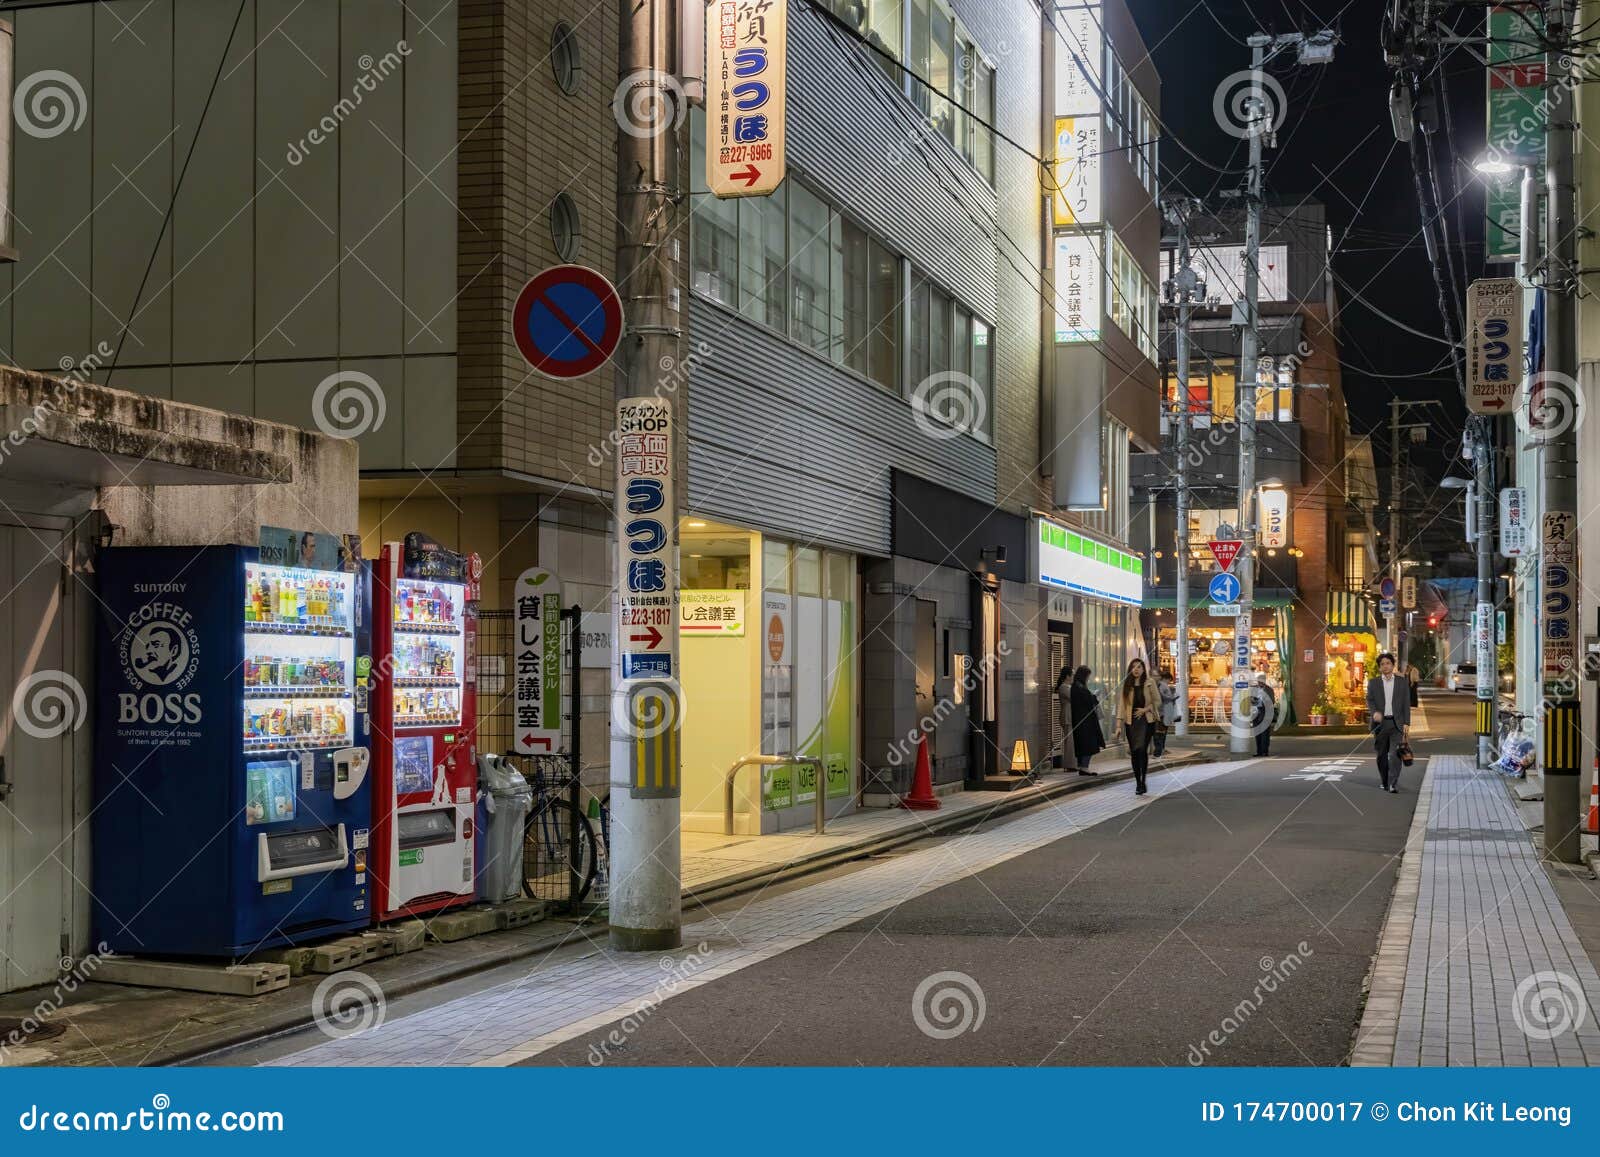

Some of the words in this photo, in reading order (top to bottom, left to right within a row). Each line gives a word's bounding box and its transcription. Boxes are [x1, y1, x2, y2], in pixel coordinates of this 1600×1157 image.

[737, 0, 773, 44] 質
[730, 143, 772, 163] 227-8966
[1068, 254, 1081, 327] 貸し会議室
[621, 418, 667, 432] SHOP
[622, 433, 667, 455] 高価
[622, 455, 668, 476] 買取
[1545, 513, 1572, 541] 質
[1218, 552, 1234, 560] STOP
[133, 583, 187, 593] SUNTORY
[129, 602, 193, 629] COFFEE
[187, 628, 200, 655] BOSS
[545, 595, 558, 690] 駅前のぞみビル
[177, 657, 200, 691] COFFEE
[517, 596, 541, 729] 貸し会議室
[118, 693, 203, 725] BOSS
